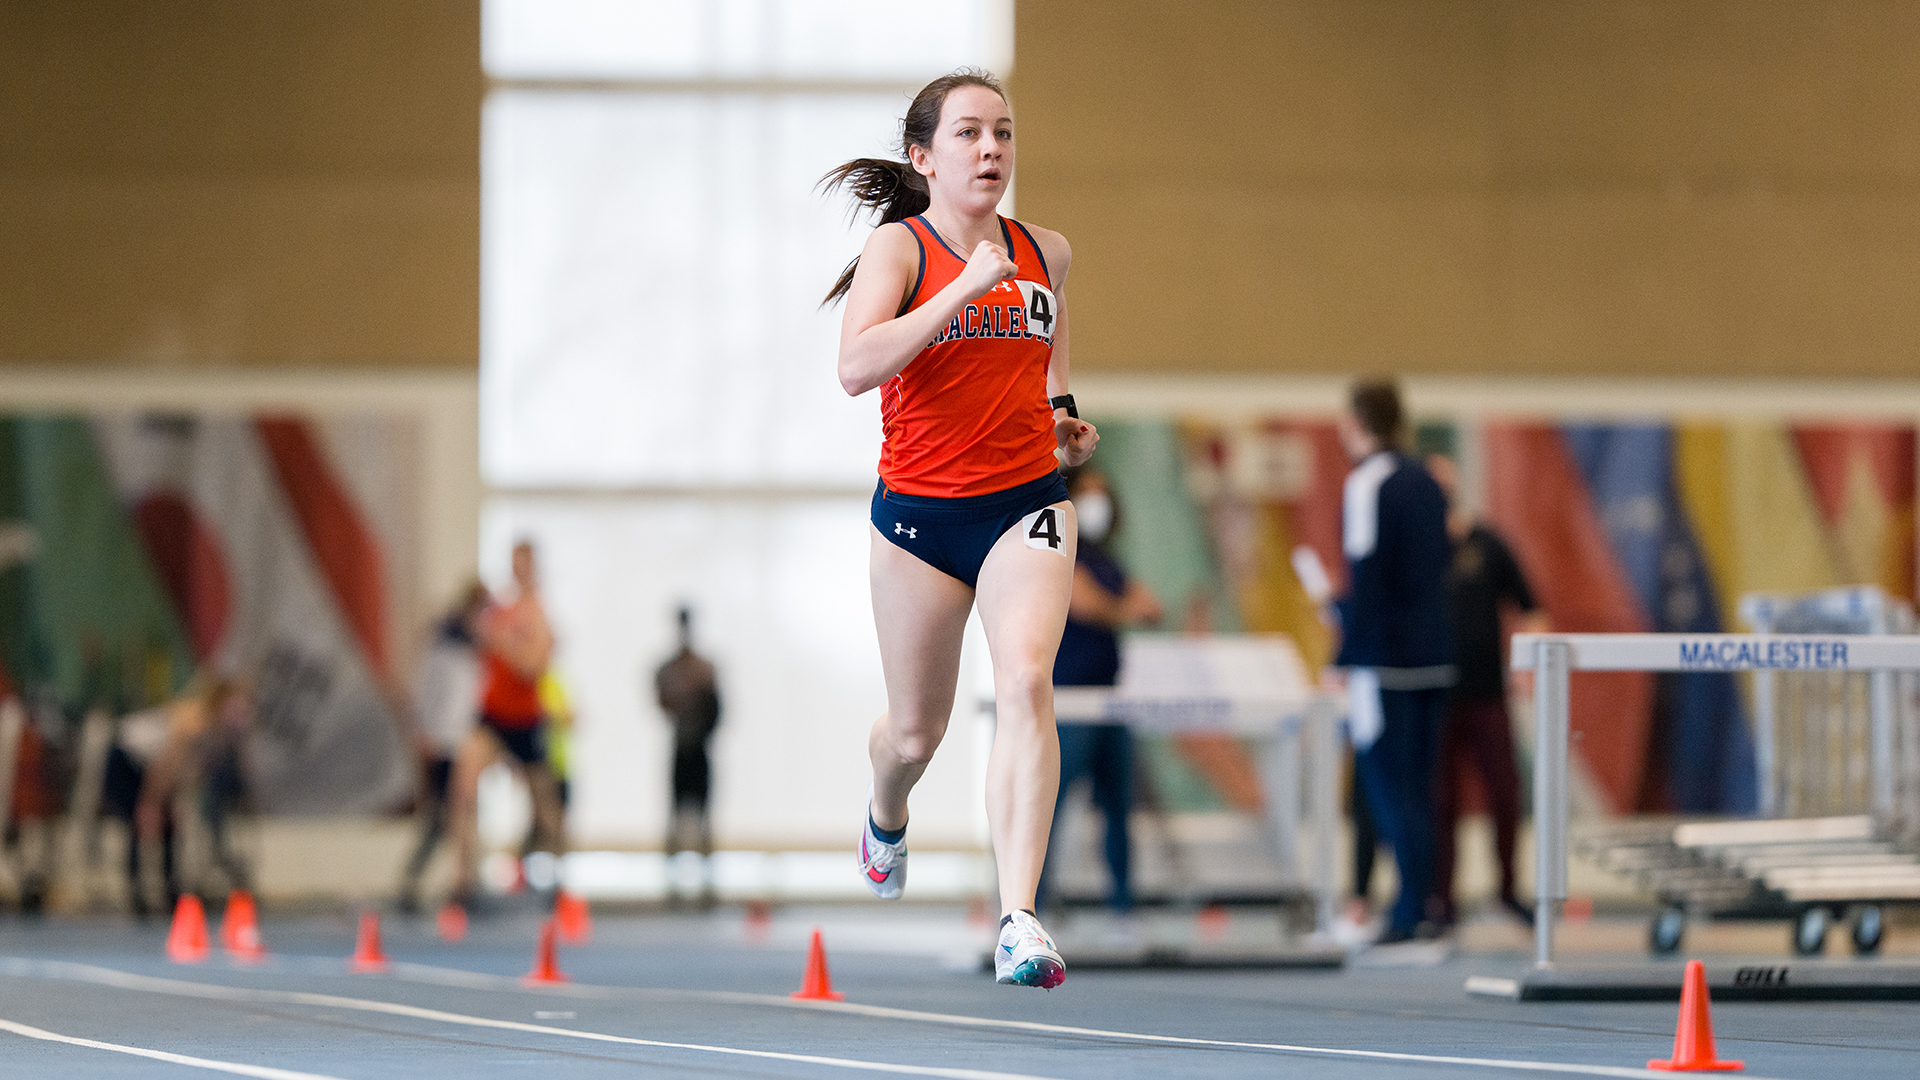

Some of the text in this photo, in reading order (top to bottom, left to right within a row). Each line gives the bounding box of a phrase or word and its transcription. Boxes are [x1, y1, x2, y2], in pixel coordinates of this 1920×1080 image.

[1030, 288, 1053, 334] 4
[1029, 508, 1062, 549] 4
[1680, 640, 1849, 668] MACALESTER
